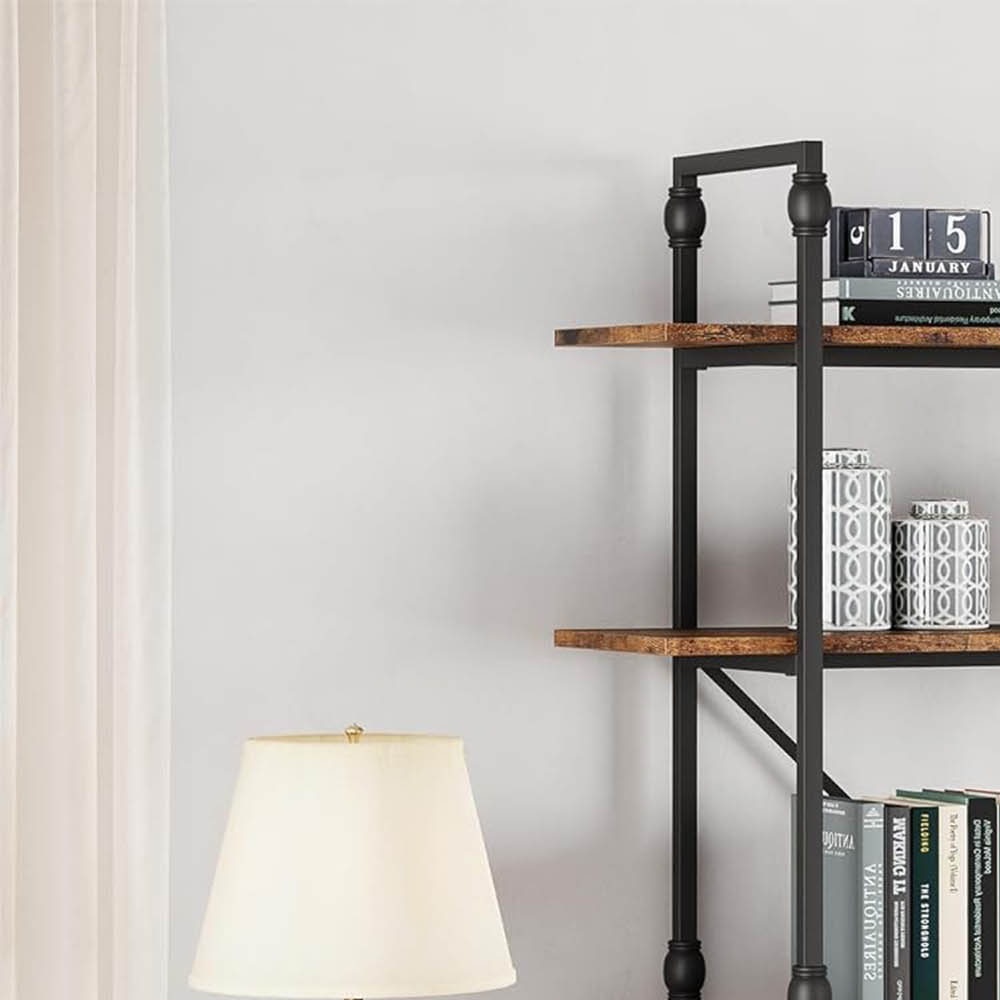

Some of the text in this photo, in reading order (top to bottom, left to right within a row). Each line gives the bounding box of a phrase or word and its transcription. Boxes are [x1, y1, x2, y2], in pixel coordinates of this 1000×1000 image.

[888, 211, 904, 251] 1
[946, 215, 967, 254] 5
[888, 260, 972, 274] JANUARY
[920, 813, 929, 853] FIELDING
[920, 883, 930, 959] THE STRONGHOLD
